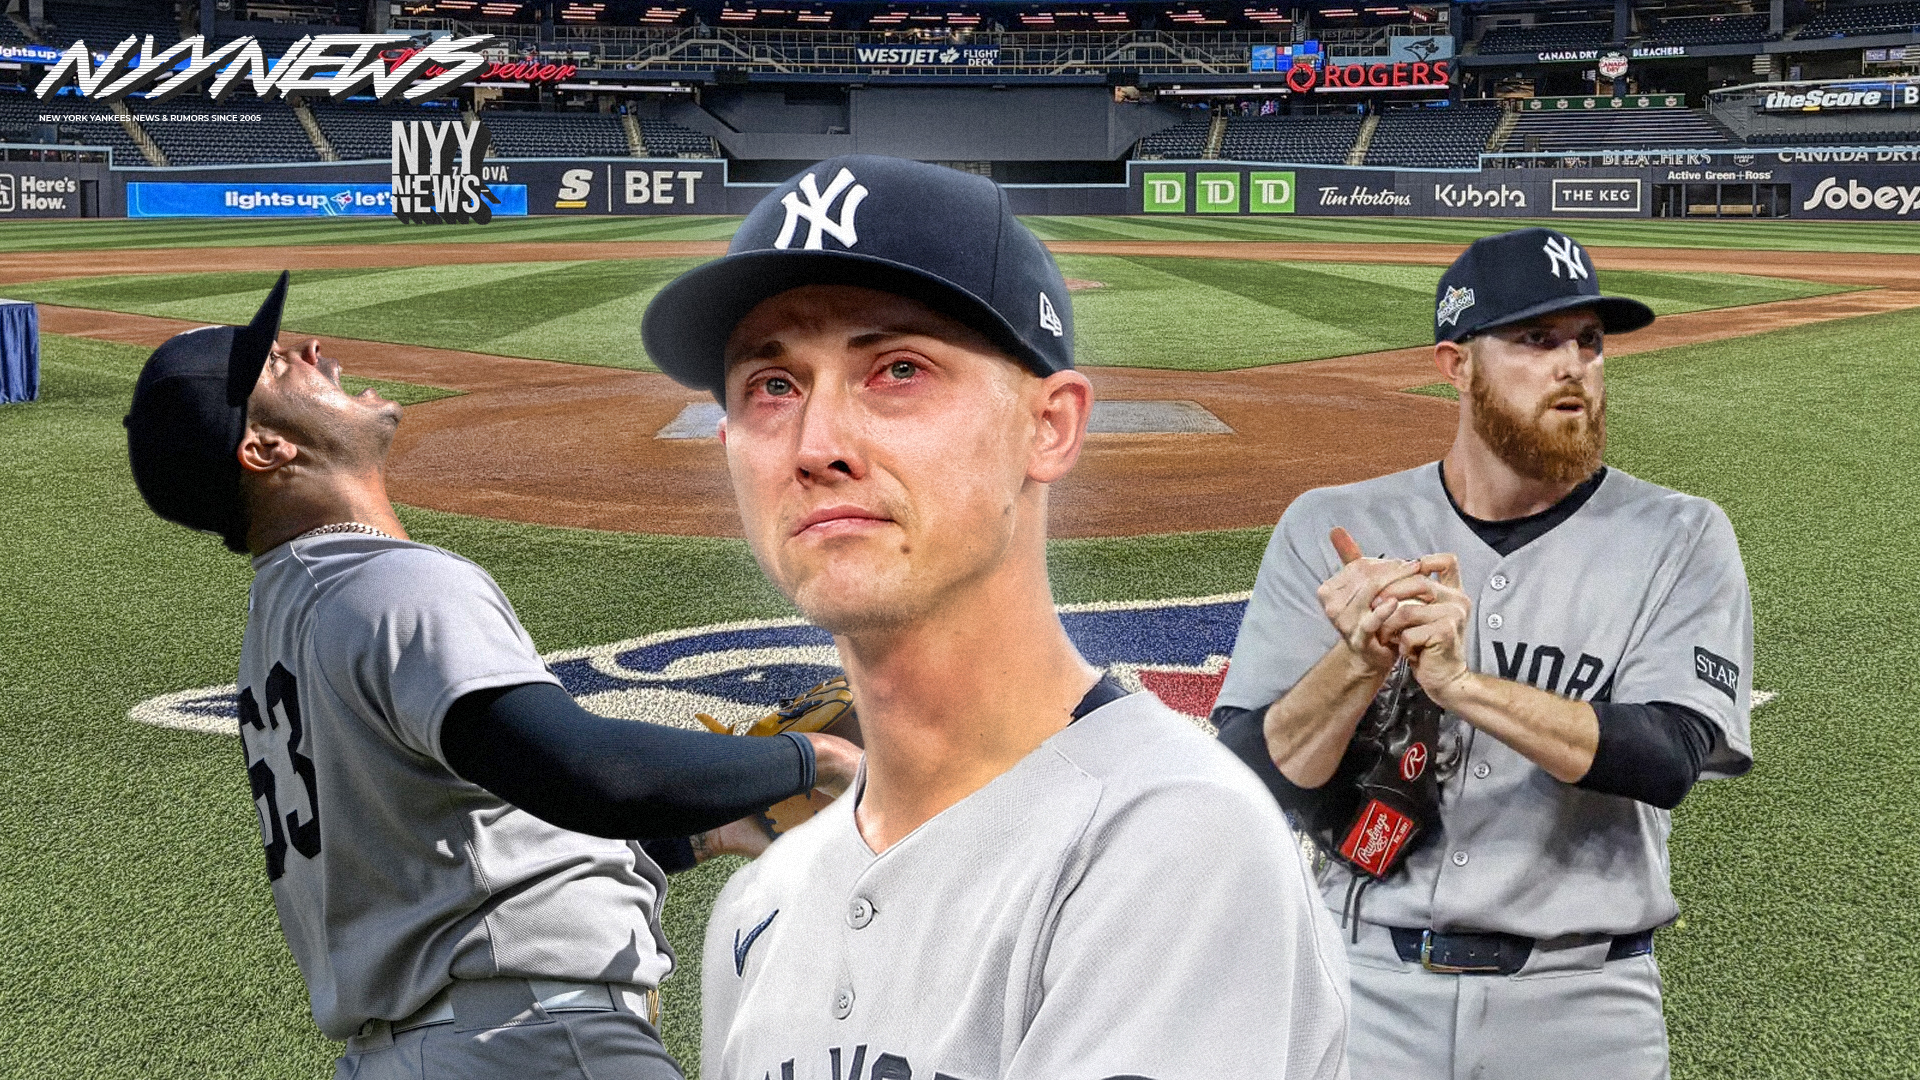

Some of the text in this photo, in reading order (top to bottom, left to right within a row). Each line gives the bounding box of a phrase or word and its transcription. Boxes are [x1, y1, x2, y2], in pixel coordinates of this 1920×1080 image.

[38, 51, 57, 60] up
[857, 48, 938, 66] WESTJET
[963, 49, 999, 59] FLIGHT
[1538, 50, 1598, 61] CANADA DRY
[1632, 47, 1685, 57] BLEACHERS
[968, 58, 994, 66] DECK
[1325, 61, 1449, 87] ROGERS
[1765, 89, 1882, 109] theScore
[481, 165, 509, 181] OVA
[1667, 171, 1701, 180] Active
[21, 176, 76, 192] Here's
[625, 170, 704, 205] BET
[1148, 180, 1182, 204] TD
[1201, 180, 1235, 204] TD
[1255, 180, 1290, 204] TD
[21, 193, 66, 209] How.
[225, 191, 393, 209] lights up let'
[1318, 186, 1411, 206] Tim Hortons
[1435, 184, 1527, 207] Kubota
[1562, 190, 1631, 201] THE KEG
[1803, 176, 1920, 215] Sobey
[1543, 236, 1589, 281] NY
[1492, 641, 1613, 702] YOR
